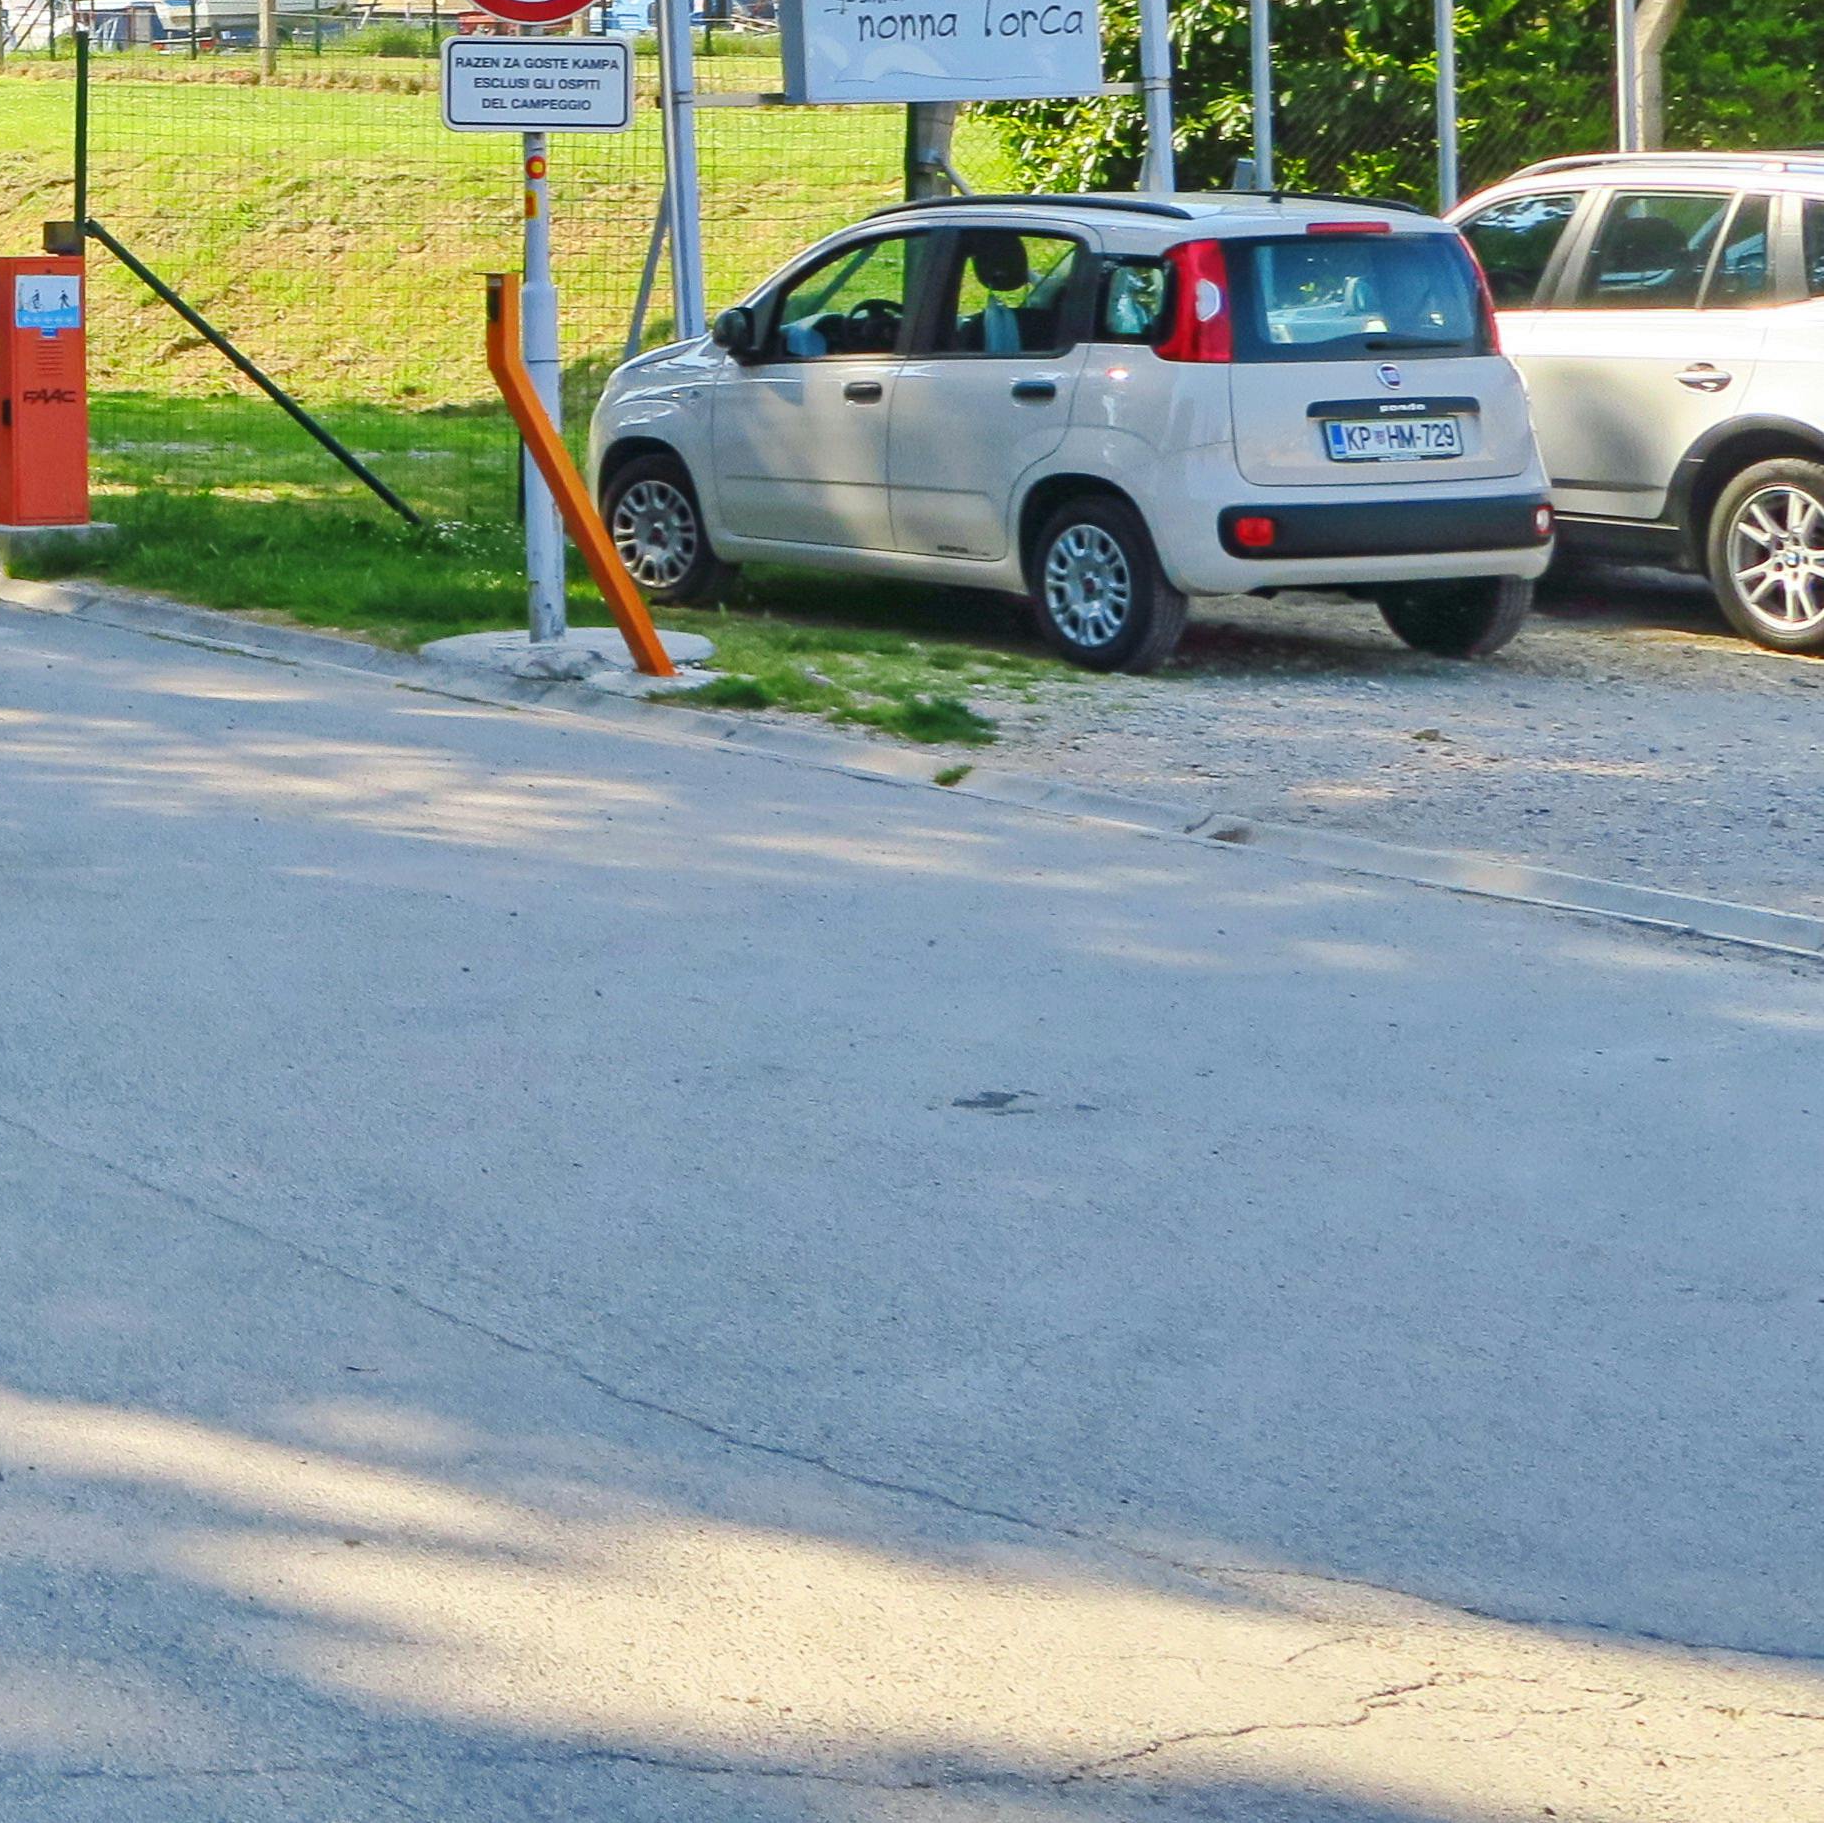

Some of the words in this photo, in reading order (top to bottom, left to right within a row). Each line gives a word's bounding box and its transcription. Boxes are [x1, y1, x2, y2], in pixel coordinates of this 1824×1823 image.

[857, 13, 958, 42] nonna
[455, 57, 500, 69] RAZEN
[503, 57, 520, 69] ZA
[524, 58, 569, 70] GOSTE
[572, 58, 620, 71] KAMPA
[474, 77, 529, 89] ESCLUSI
[533, 78, 554, 90] GLI
[558, 78, 601, 91] OSPITI
[481, 98, 508, 110] DEL
[511, 98, 592, 111] CAMPEGGIO
[22, 388, 77, 405] FAAC
[1345, 425, 1371, 451] KP
[1386, 423, 1455, 450] HM-729
